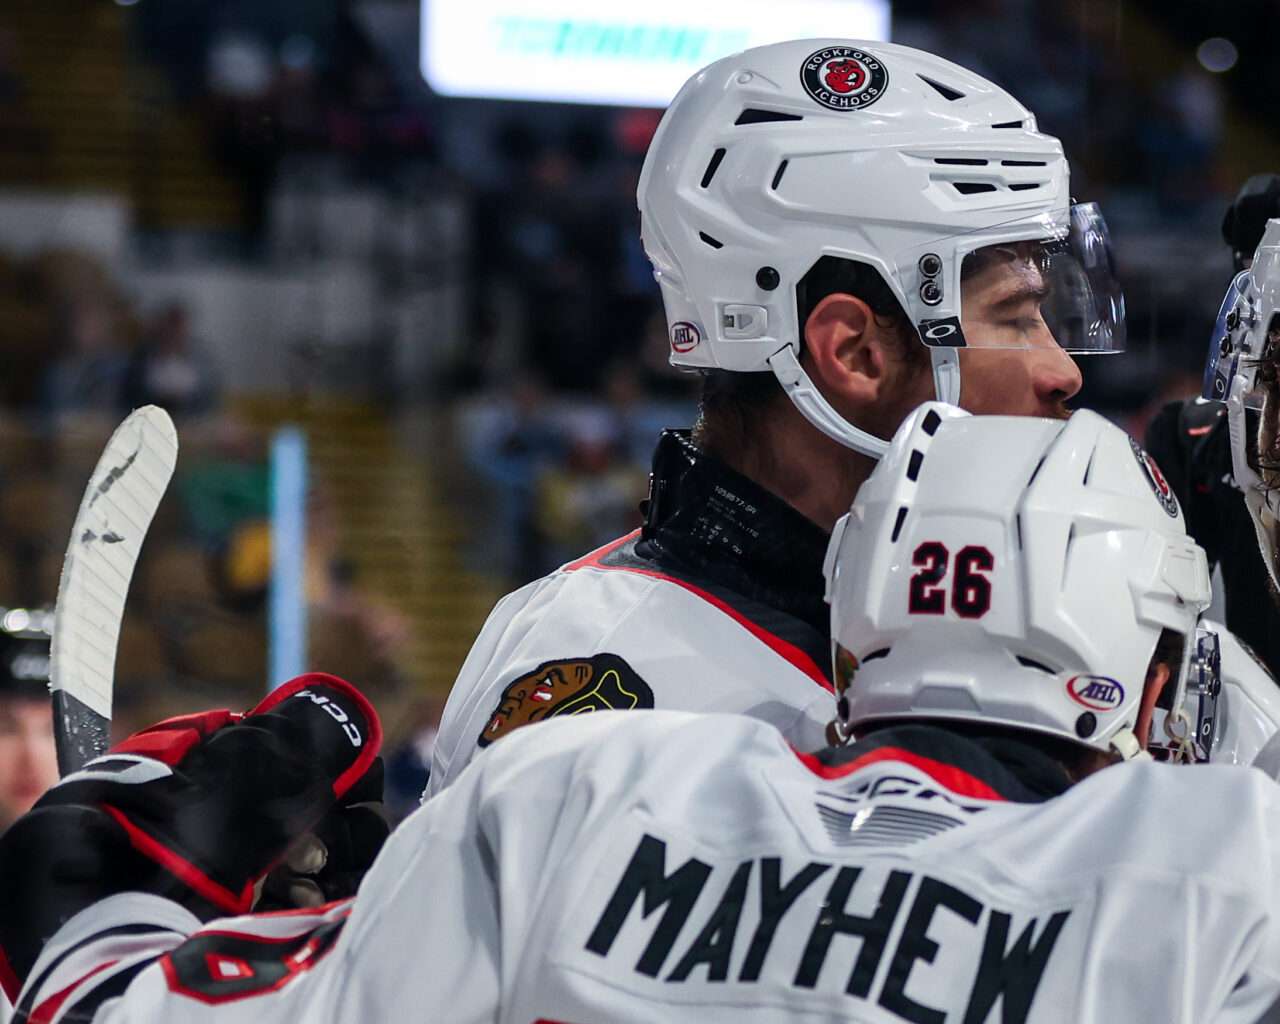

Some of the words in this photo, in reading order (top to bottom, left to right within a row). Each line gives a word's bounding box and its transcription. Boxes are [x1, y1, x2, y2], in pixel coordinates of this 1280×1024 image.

[807, 49, 880, 71] ROCKFORD
[814, 87, 879, 107] ICEHOGS
[908, 541, 995, 620] 26
[1078, 682, 1116, 704] AHL
[295, 689, 362, 747] CCM
